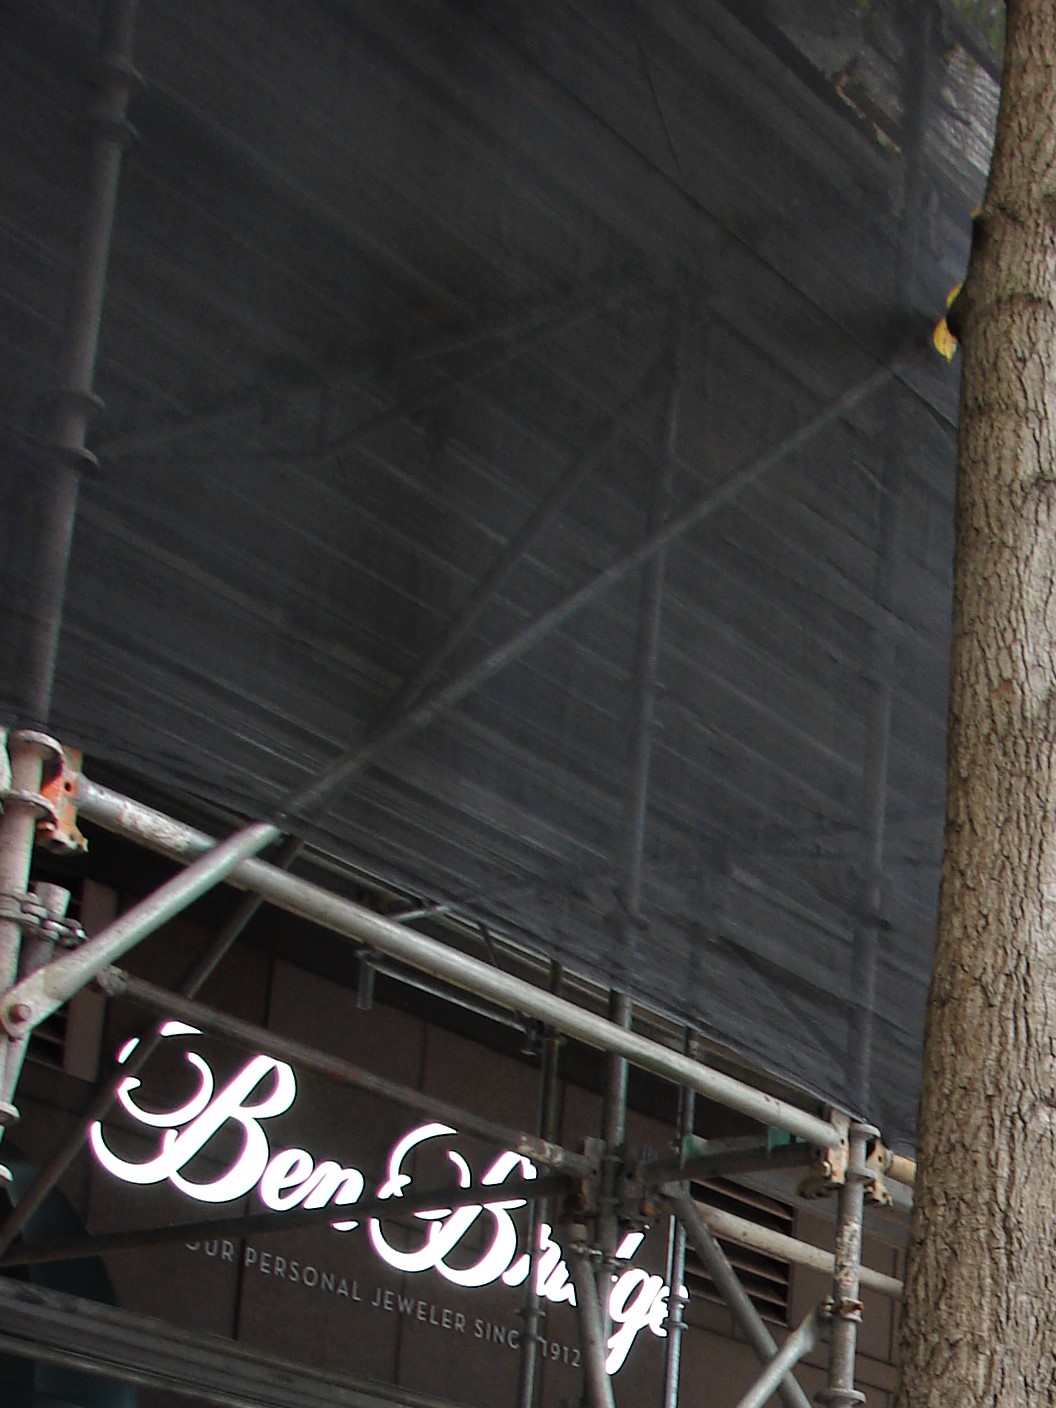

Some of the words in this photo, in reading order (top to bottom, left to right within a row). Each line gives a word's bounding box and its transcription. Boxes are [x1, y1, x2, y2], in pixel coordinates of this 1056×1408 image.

[90, 1021, 364, 1231] Ben
[245, 1246, 362, 1302] PERSONAL
[371, 1287, 466, 1333] JEWELER
[473, 1319, 521, 1349] SINC
[539, 1338, 582, 1368] 1912
